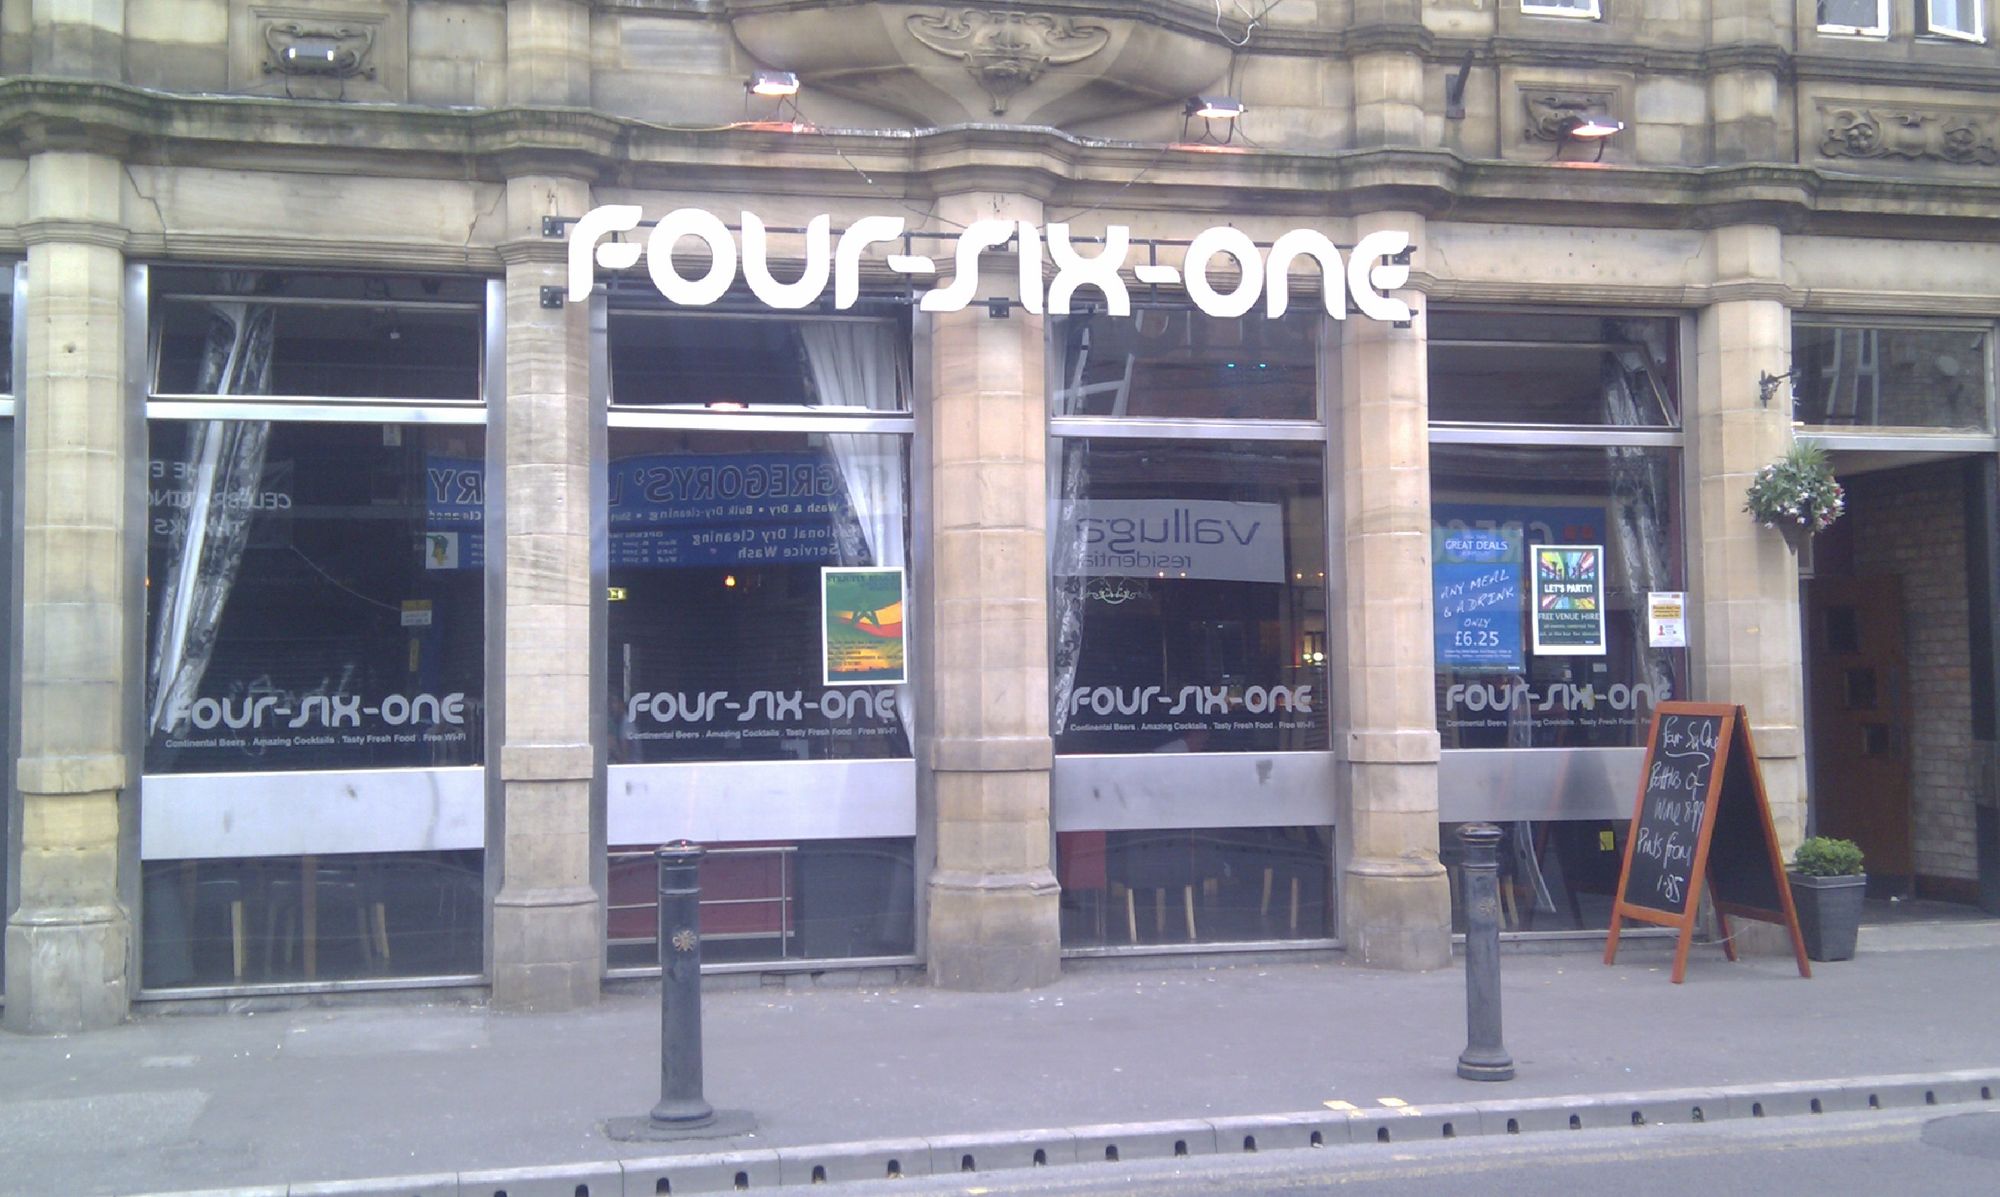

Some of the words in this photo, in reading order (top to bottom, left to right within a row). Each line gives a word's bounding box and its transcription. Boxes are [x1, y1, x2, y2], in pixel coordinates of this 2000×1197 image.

[1445, 540, 1473, 551] GREAT
[1475, 540, 1508, 551] DEALS
[1441, 582, 1465, 599] ANY
[1470, 569, 1510, 591] MEAL
[1467, 586, 1514, 611] DRINK
[1455, 631, 1499, 647] £6.25
[706, 730, 740, 739] Amazing
[742, 729, 779, 737] Cocktails
[786, 728, 806, 737] Tasty
[808, 727, 830, 736] Fresh
[858, 727, 876, 735] Free
[1070, 723, 1112, 731] Continental
[1141, 723, 1172, 731] Amazing
[1174, 722, 1207, 730] Cocktails
[1213, 722, 1231, 730] Tasty
[1279, 721, 1295, 729] Free
[165, 739, 217, 748] Continental
[219, 738, 246, 747] Beers
[253, 736, 291, 747] Amazing
[293, 735, 335, 744] Cocktails
[341, 735, 365, 745] Tasty
[367, 734, 391, 743] Fresh
[394, 733, 416, 742] Food
[423, 733, 442, 742] Free
